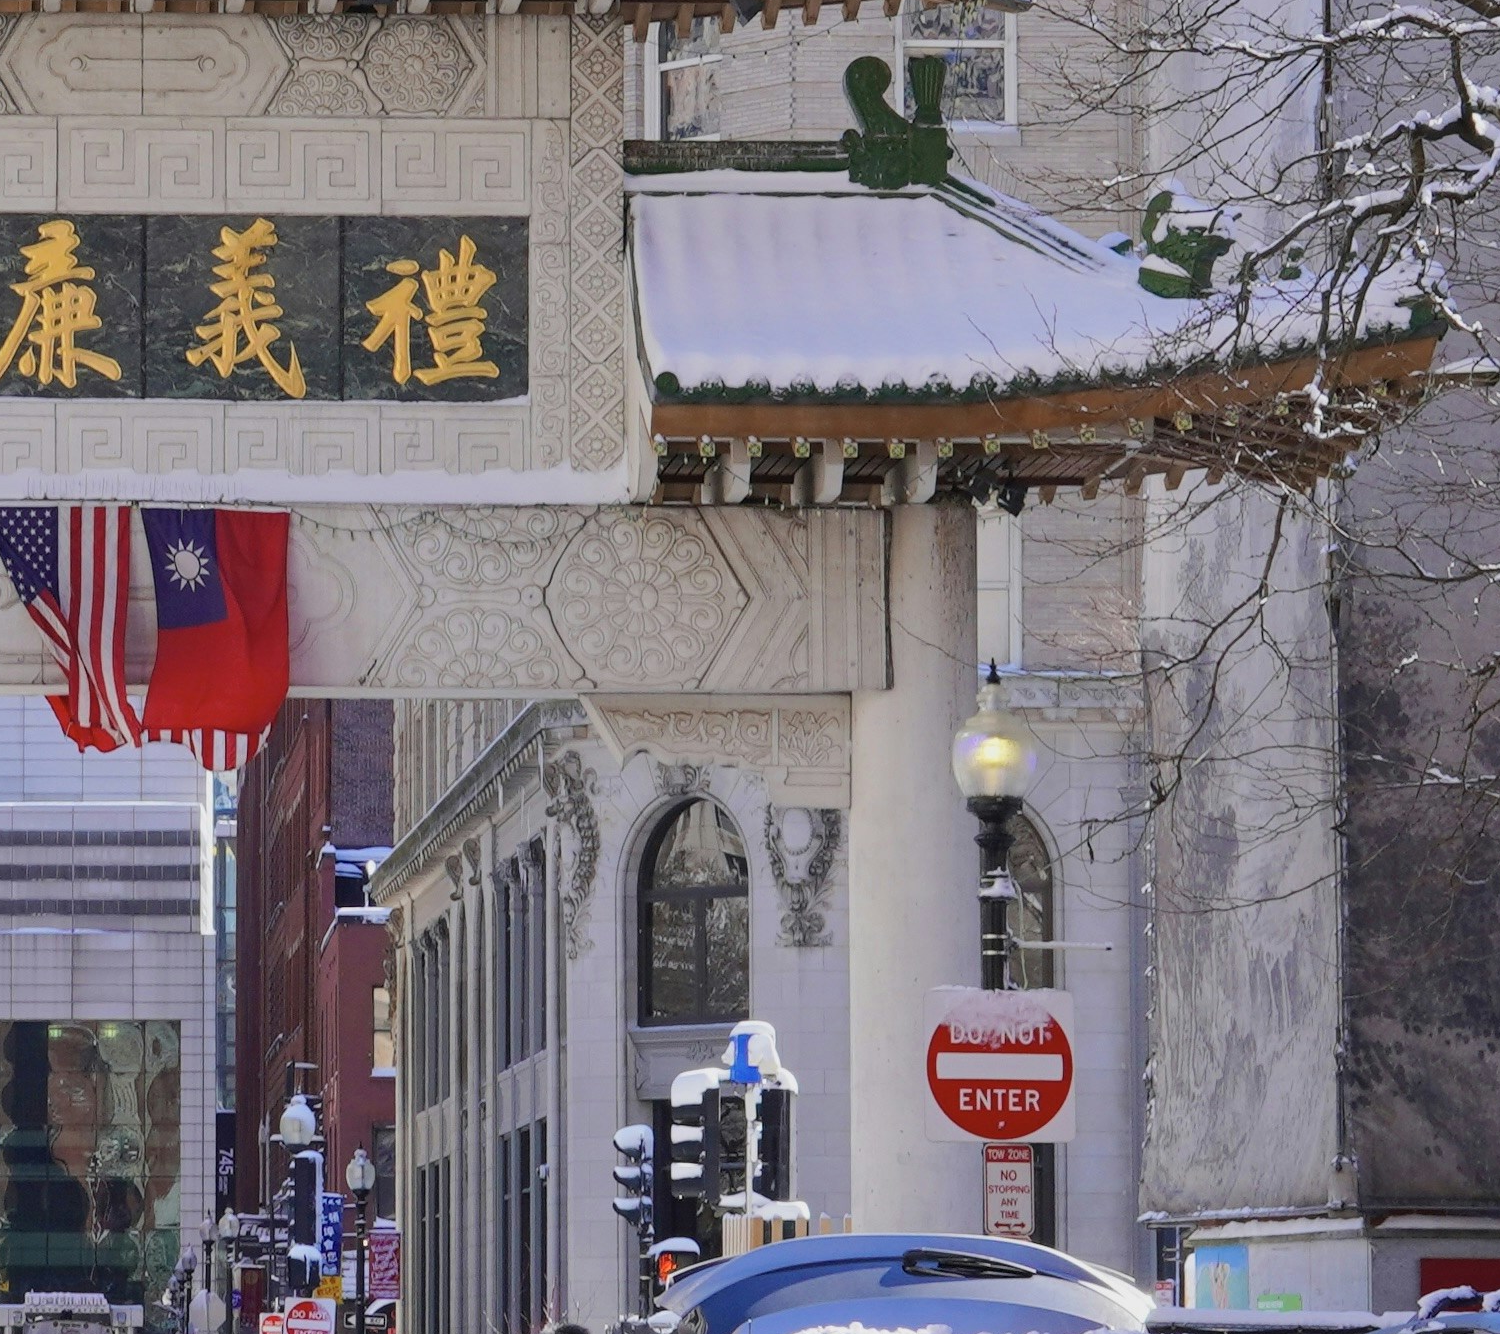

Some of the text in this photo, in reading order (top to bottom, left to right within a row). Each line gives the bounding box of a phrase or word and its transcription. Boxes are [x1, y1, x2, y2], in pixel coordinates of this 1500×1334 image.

[950, 1023, 1047, 1046] DO NOT
[959, 1088, 1040, 1112] ENTER
[988, 1149, 1030, 1160] TOW ZONE
[218, 1148, 234, 1175] 745
[1001, 1169, 1017, 1181] NO
[988, 1185, 1030, 1195] STOPPING
[1001, 1199, 1018, 1207] ANY
[1000, 1211, 1019, 1220] TIME
[292, 1310, 327, 1321] DO NOT
